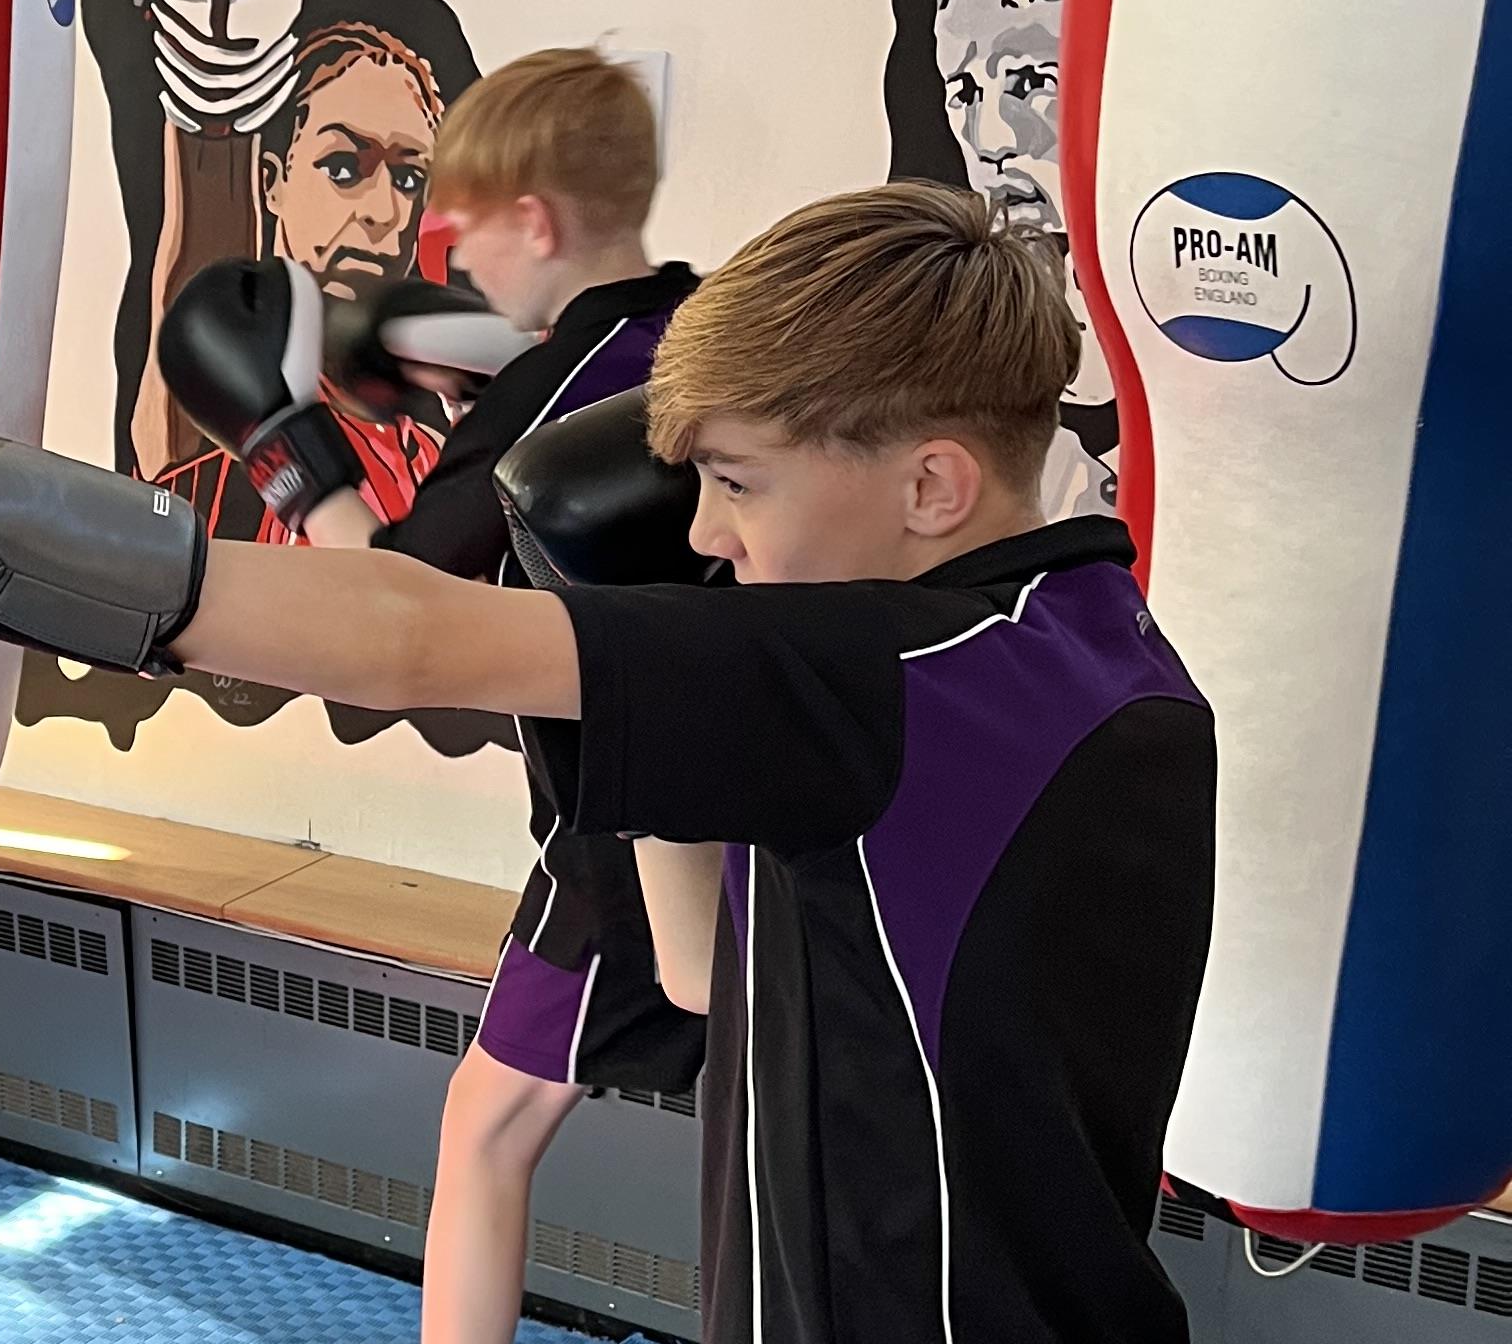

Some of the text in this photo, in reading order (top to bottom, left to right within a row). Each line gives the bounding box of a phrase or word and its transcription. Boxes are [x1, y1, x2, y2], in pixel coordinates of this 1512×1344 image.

[1173, 226, 1278, 279] PRO-AM
[1198, 267, 1249, 286] BOXING
[1194, 286, 1258, 306] ENGLAND
